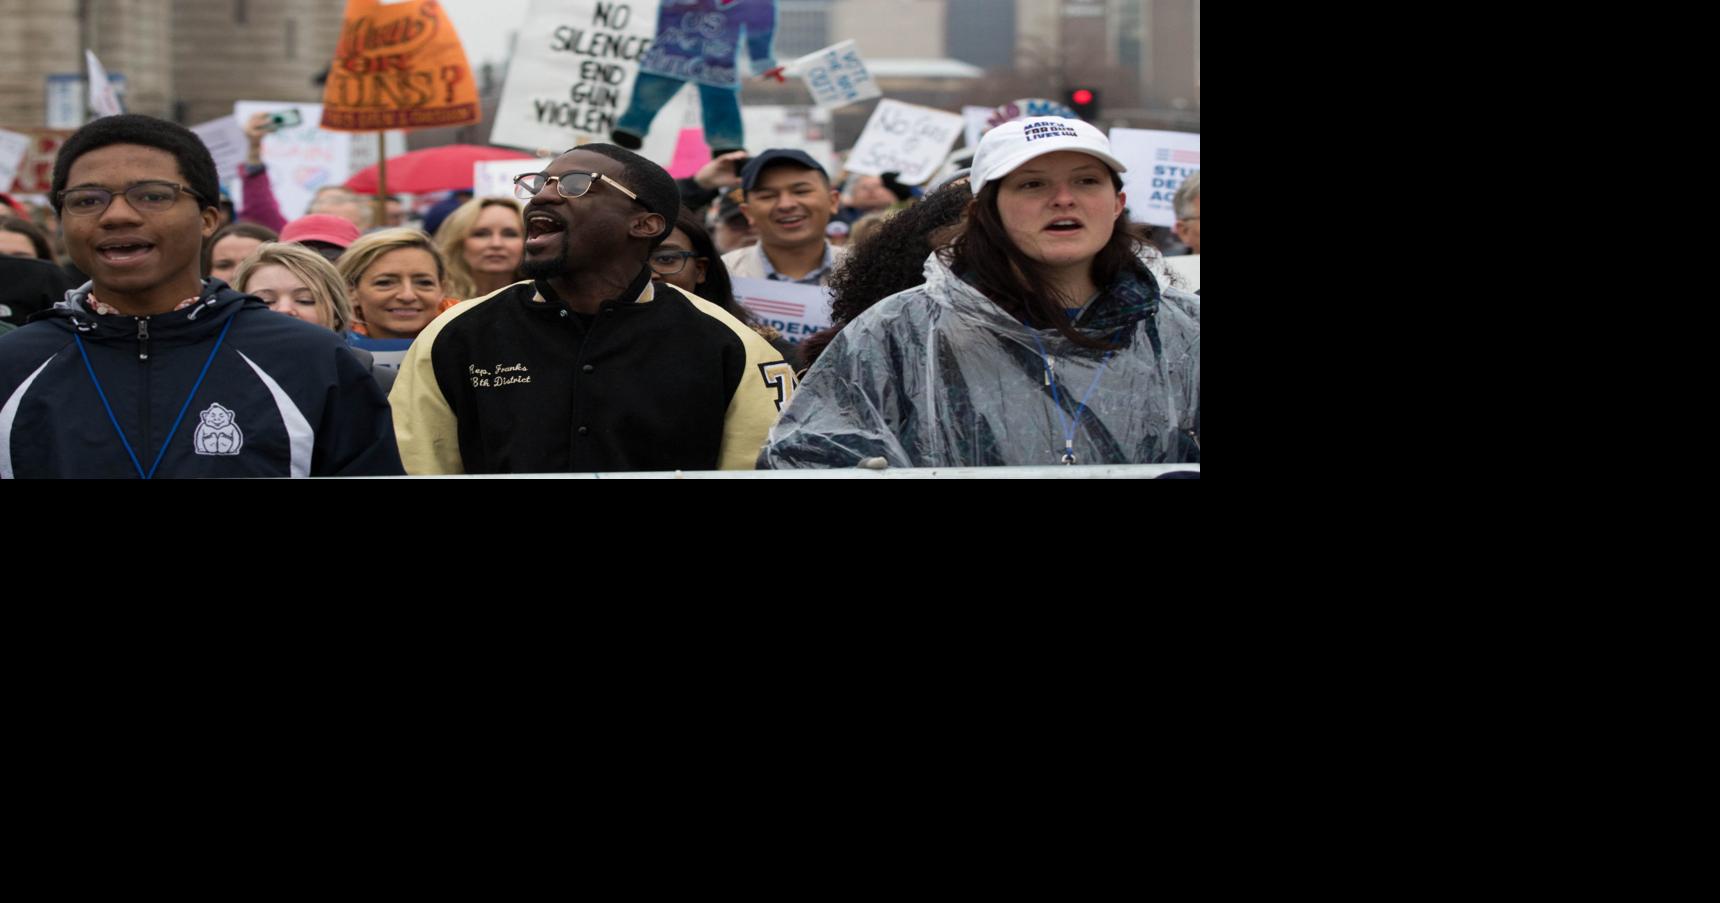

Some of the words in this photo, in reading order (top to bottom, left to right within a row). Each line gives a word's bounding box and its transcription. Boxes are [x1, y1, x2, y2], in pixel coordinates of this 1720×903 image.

[592, 2, 631, 30] NO
[550, 26, 652, 61] SILENCE
[580, 61, 625, 85] END
[571, 82, 619, 108] GUN
[1025, 126, 1049, 136] FOR
[1026, 131, 1061, 142] LIVES
[494, 362, 528, 375] Franks
[494, 375, 532, 388] District
